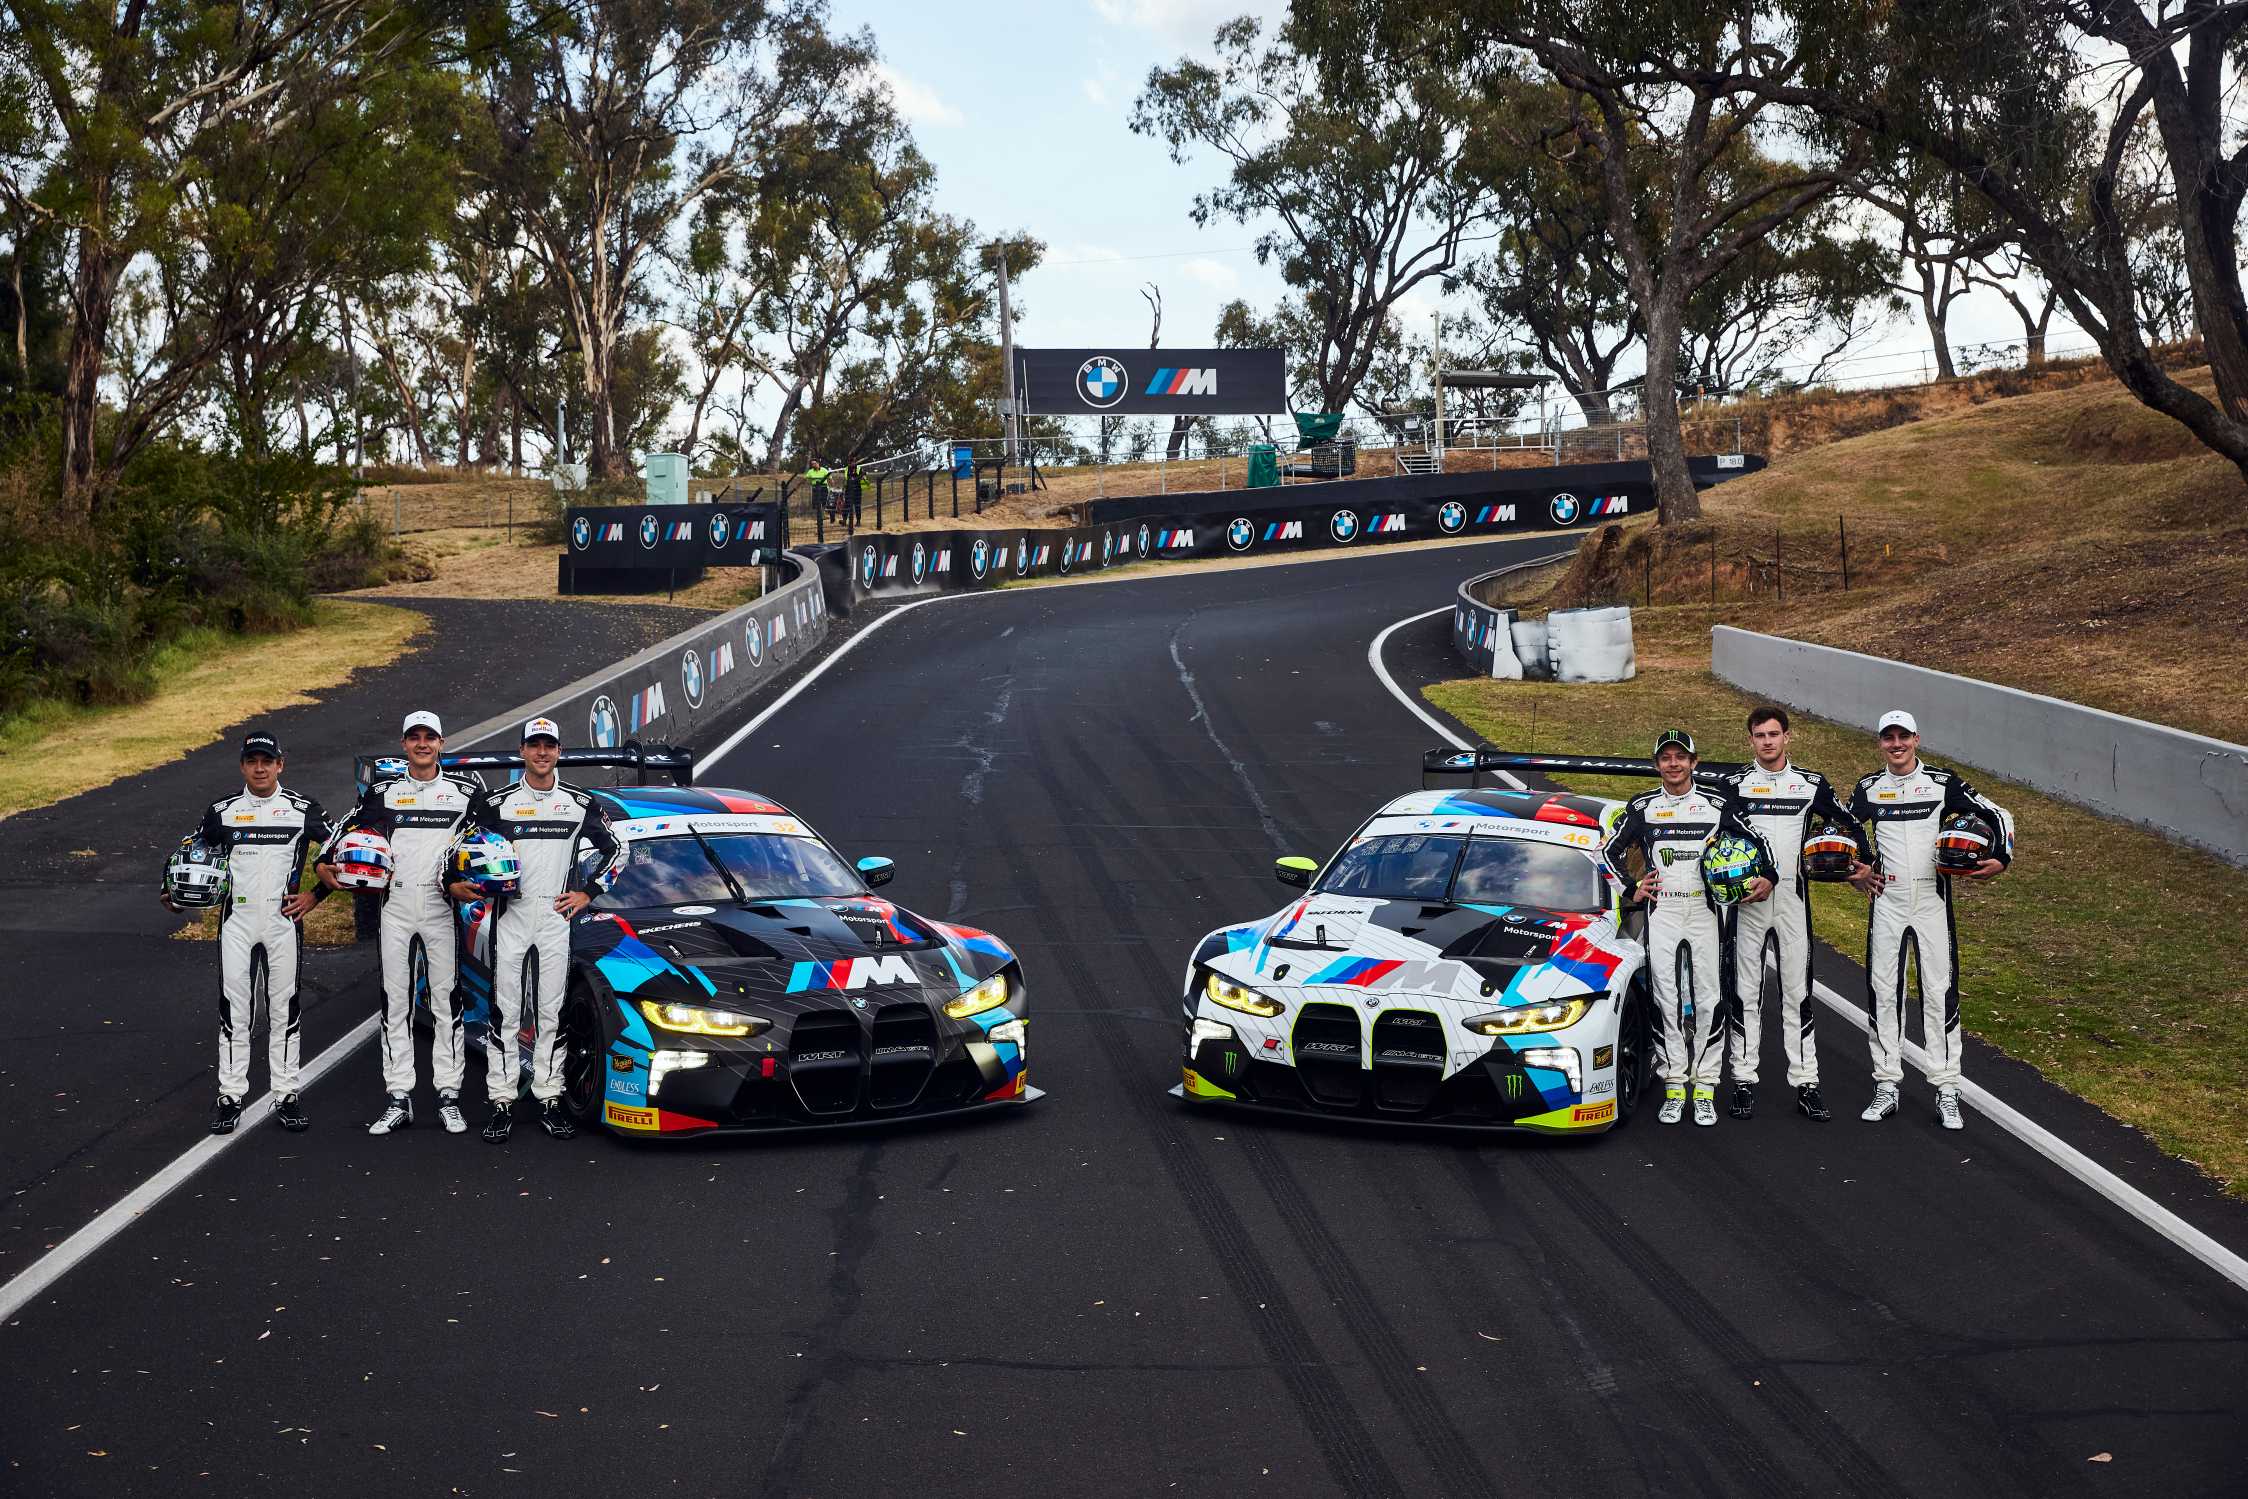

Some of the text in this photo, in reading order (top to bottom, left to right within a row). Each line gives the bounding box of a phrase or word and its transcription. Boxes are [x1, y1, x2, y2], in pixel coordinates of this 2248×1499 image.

[687, 820, 759, 829] Motorsport
[772, 822, 798, 833] 32
[1475, 822, 1551, 837] Motorsport
[1562, 832, 1591, 846] 46
[839, 915, 889, 924] Motorsport
[638, 921, 702, 936] SKECHERS
[1503, 926, 1561, 941] Motorsport
[610, 1078, 640, 1094] ENDLESS
[608, 1106, 654, 1126] PIRELLI
[1574, 1103, 1614, 1122] PIRELLI
